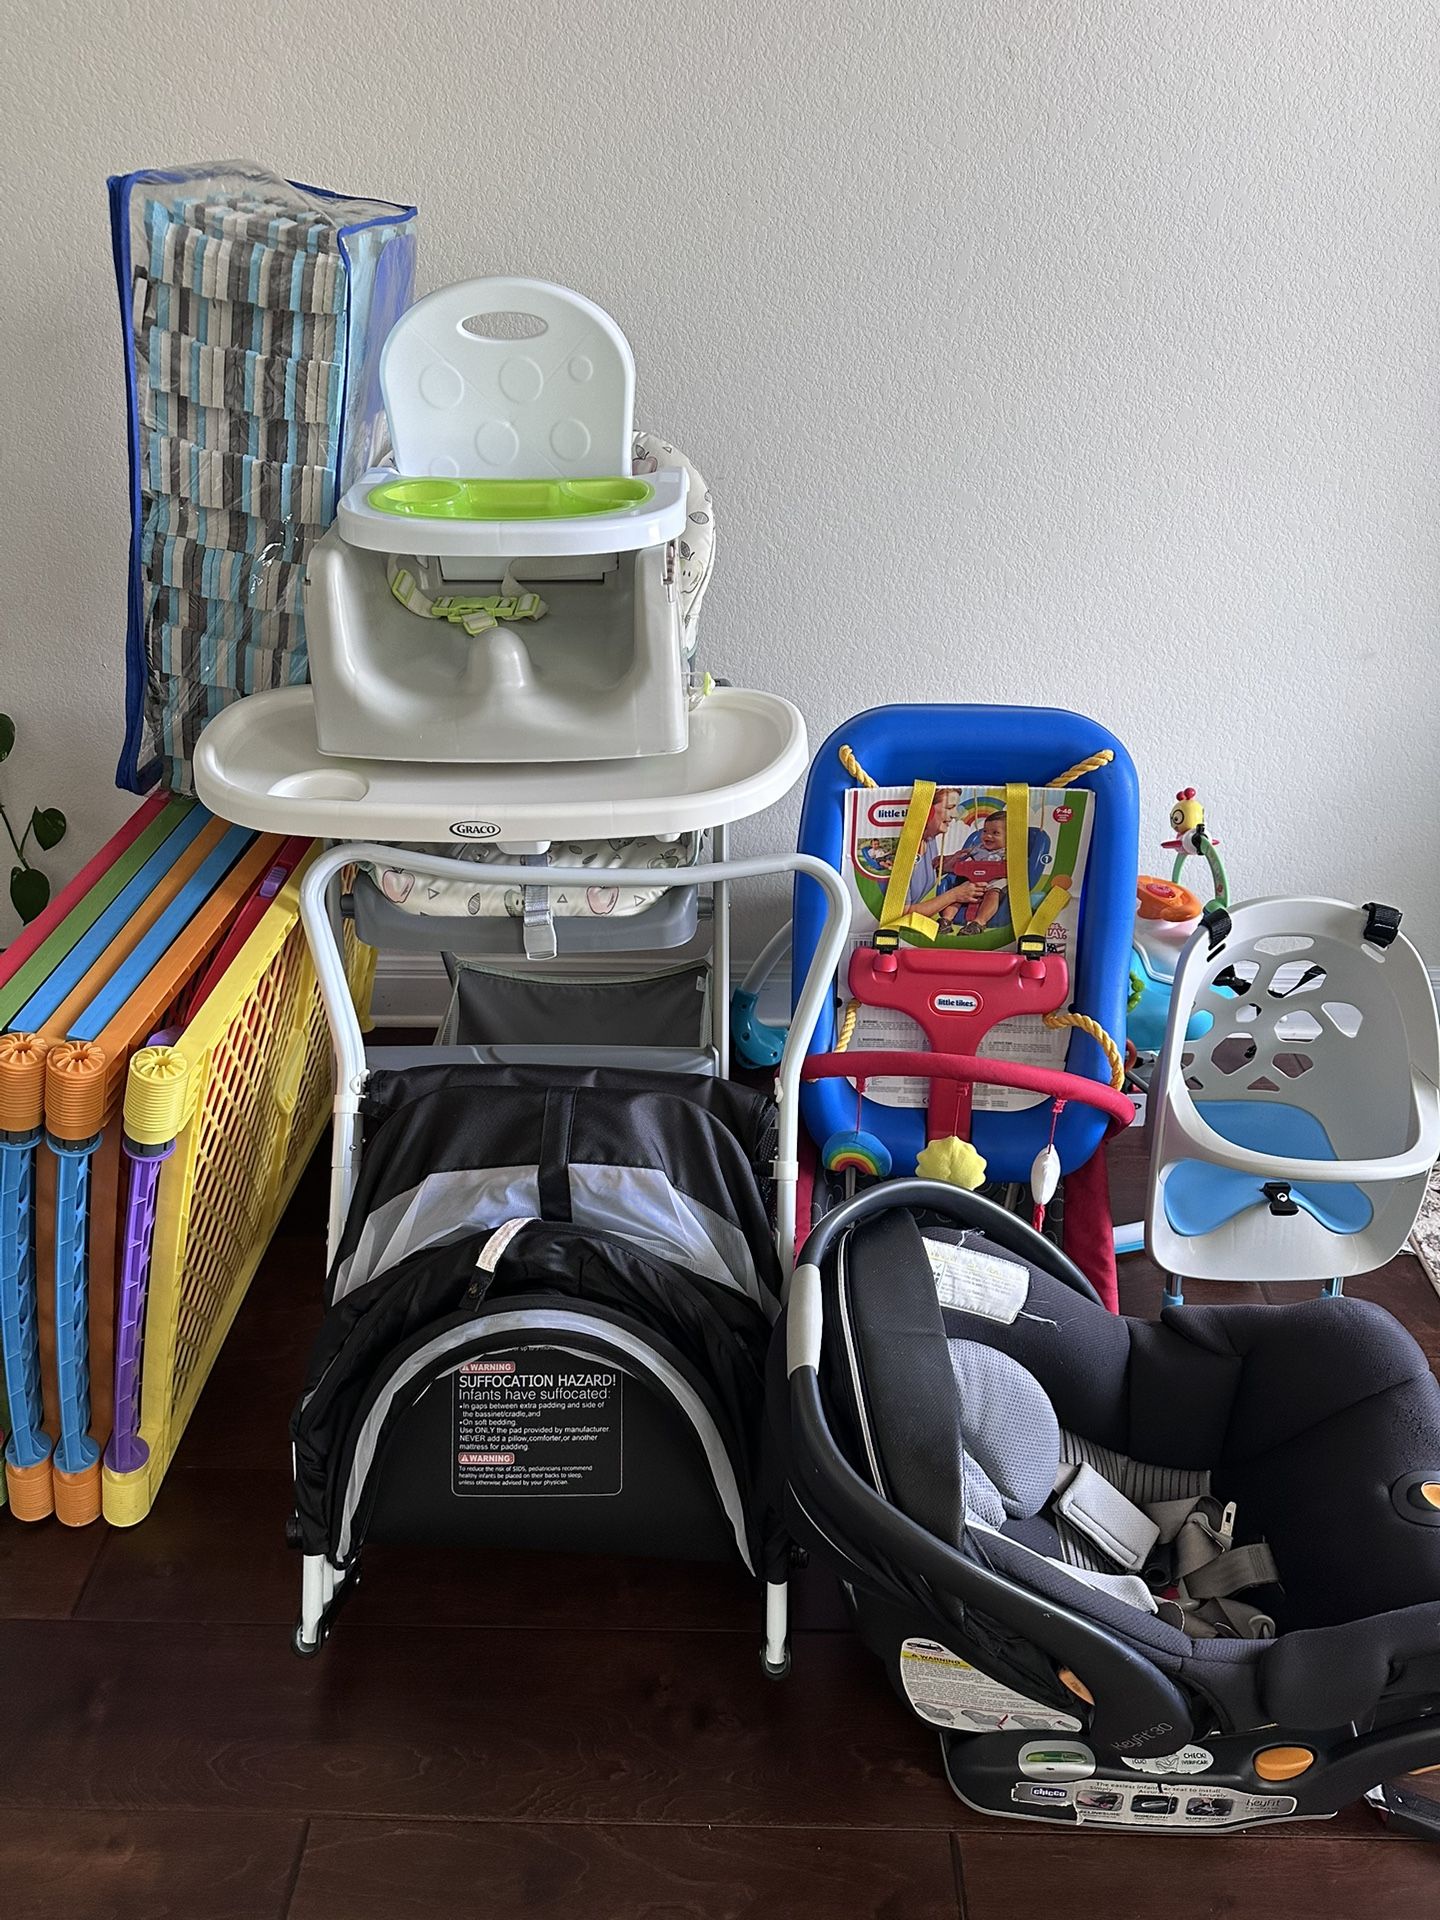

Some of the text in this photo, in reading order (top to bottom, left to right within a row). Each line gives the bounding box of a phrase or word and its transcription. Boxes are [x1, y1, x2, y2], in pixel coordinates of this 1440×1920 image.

[878, 809, 900, 818] little
[456, 824, 496, 834] GRACO
[1046, 927, 1067, 940] LAY.
[938, 998, 955, 1006] little
[470, 1363, 511, 1371] WARNING
[459, 1374, 616, 1388] SUFFOCATION HAZARD!
[459, 1387, 611, 1400] Infants have suffocated:
[470, 1403, 488, 1411] gaps
[538, 1402, 566, 1410] padding
[462, 1410, 474, 1418] the
[463, 1418, 474, 1426] On
[474, 1418, 488, 1426] soft
[508, 1427, 522, 1435] pad
[523, 1426, 553, 1435] provided
[554, 1426, 563, 1435] by
[459, 1434, 486, 1442] NEVER
[486, 1434, 501, 1442] add
[469, 1454, 510, 1463] WARNING
[920, 1655, 961, 1665] WARNING
[1110, 1722, 1173, 1751] KeyFit 30
[1033, 1788, 1066, 1798] chicco
